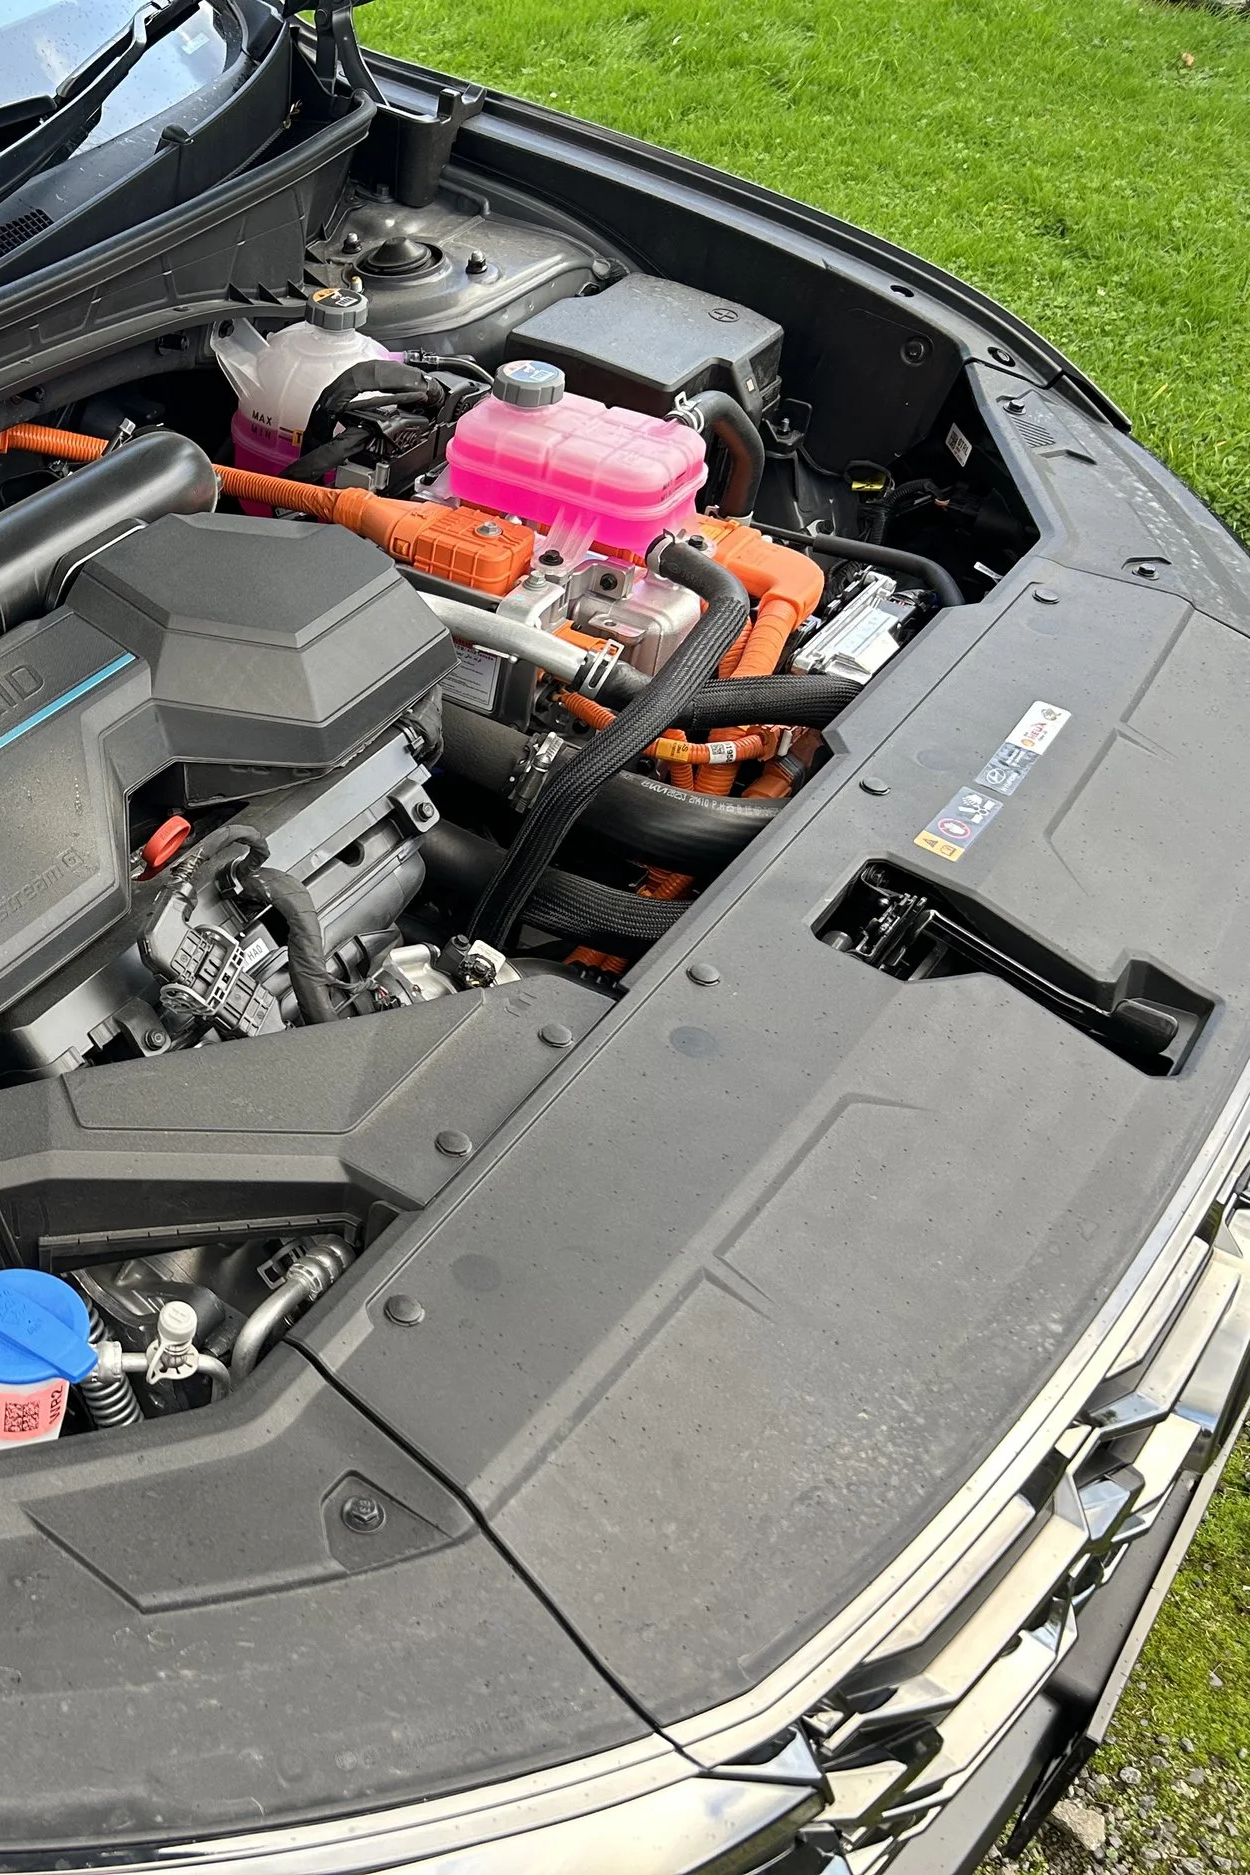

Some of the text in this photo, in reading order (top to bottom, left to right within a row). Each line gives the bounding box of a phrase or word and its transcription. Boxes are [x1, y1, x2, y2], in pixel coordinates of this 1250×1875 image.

[252, 410, 272, 426] MAX
[251, 424, 271, 440] MIN
[61, 846, 85, 868] G
